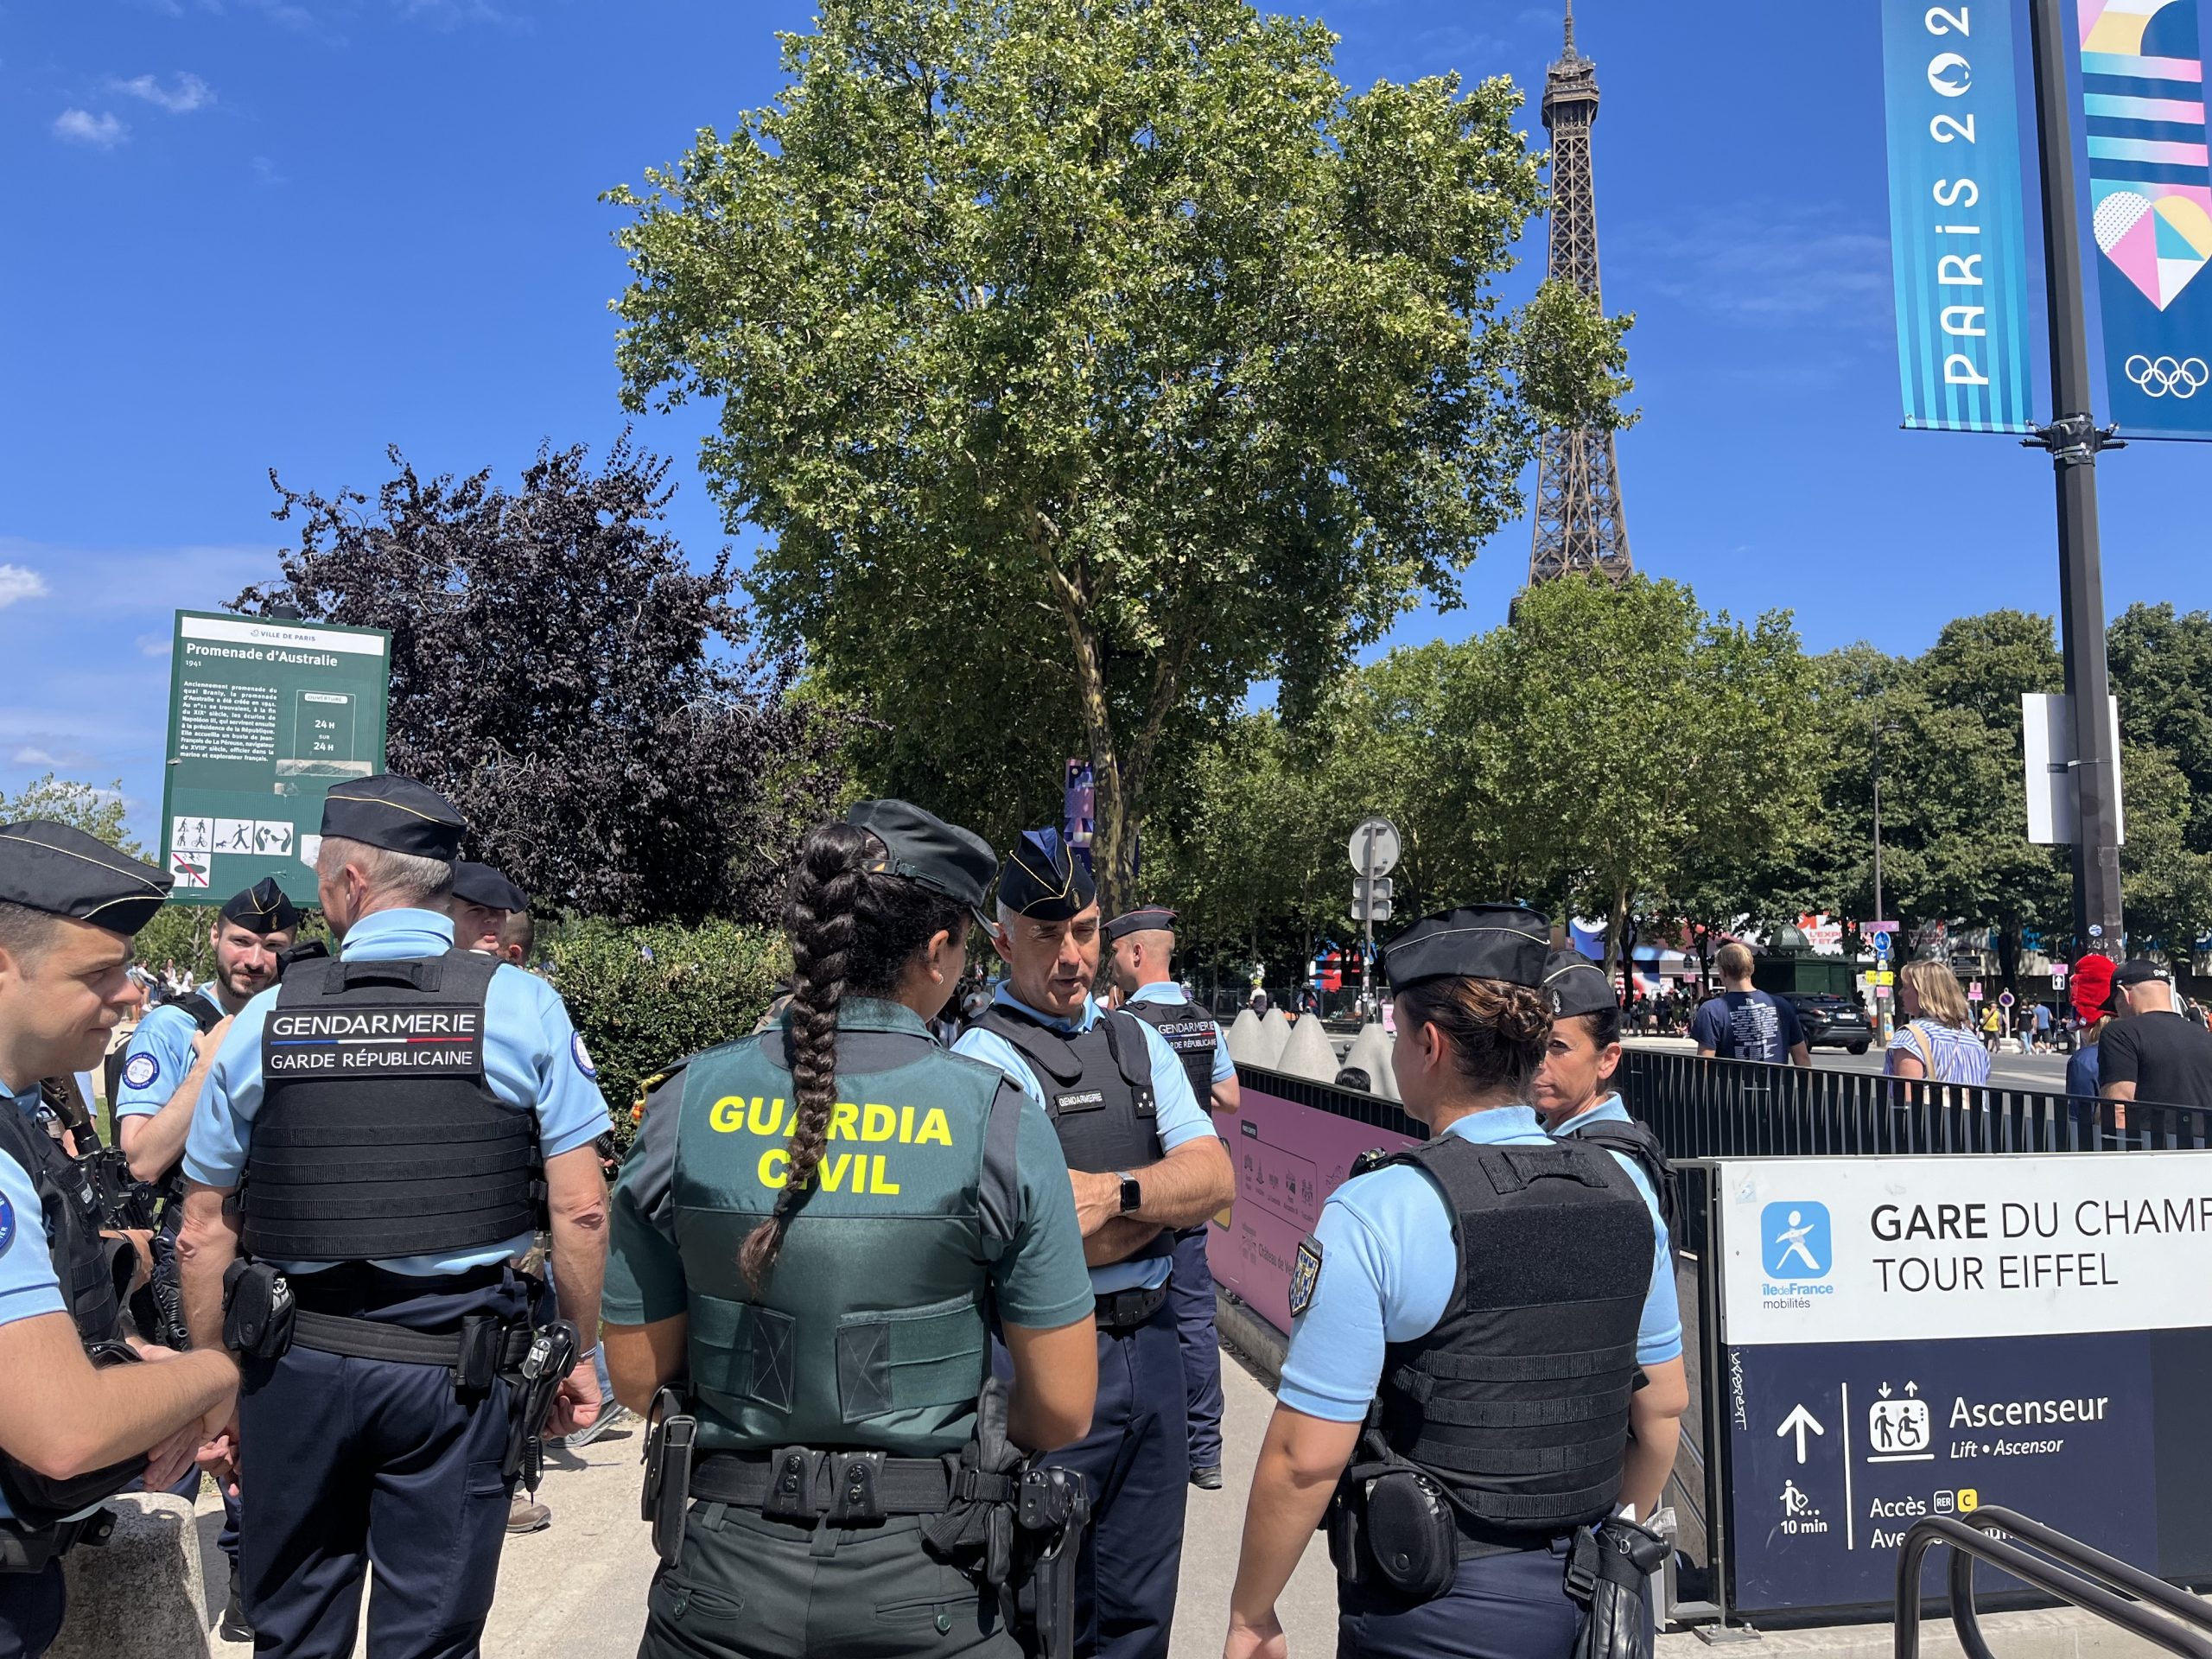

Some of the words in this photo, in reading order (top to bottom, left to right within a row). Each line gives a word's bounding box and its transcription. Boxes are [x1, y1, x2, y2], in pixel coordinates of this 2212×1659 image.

[187, 643, 263, 659] Promenade
[266, 650, 338, 666] d'Australie
[315, 720, 327, 728] 24
[314, 742, 326, 751] 24
[272, 1014, 476, 1035] GENDARMERIE
[1159, 1021, 1214, 1033] GENDARMERIE
[270, 1054, 335, 1069] GARDE
[343, 1049, 473, 1067] RÉPUBLICAINE
[1059, 1093, 1103, 1107] GENDARMERIE
[757, 1148, 900, 1194] CVIL
[1870, 1204, 1988, 1242] GARE
[2002, 1202, 2058, 1238] DU
[1872, 1256, 1985, 1293] TOUR
[1999, 1253, 2119, 1289] EIFFEL
[1763, 1298, 1810, 1309] mobilités
[1949, 1395, 2108, 1429] Ascenseur
[1950, 1440, 1978, 1459] Lift
[1993, 1439, 2063, 1457] Ascensor
[1870, 1497, 1926, 1518] Accès
[1936, 1497, 1951, 1508] RER
[1963, 1495, 1971, 1506] C
[1781, 1519, 1798, 1535] 10
[1801, 1518, 1827, 1535] min
